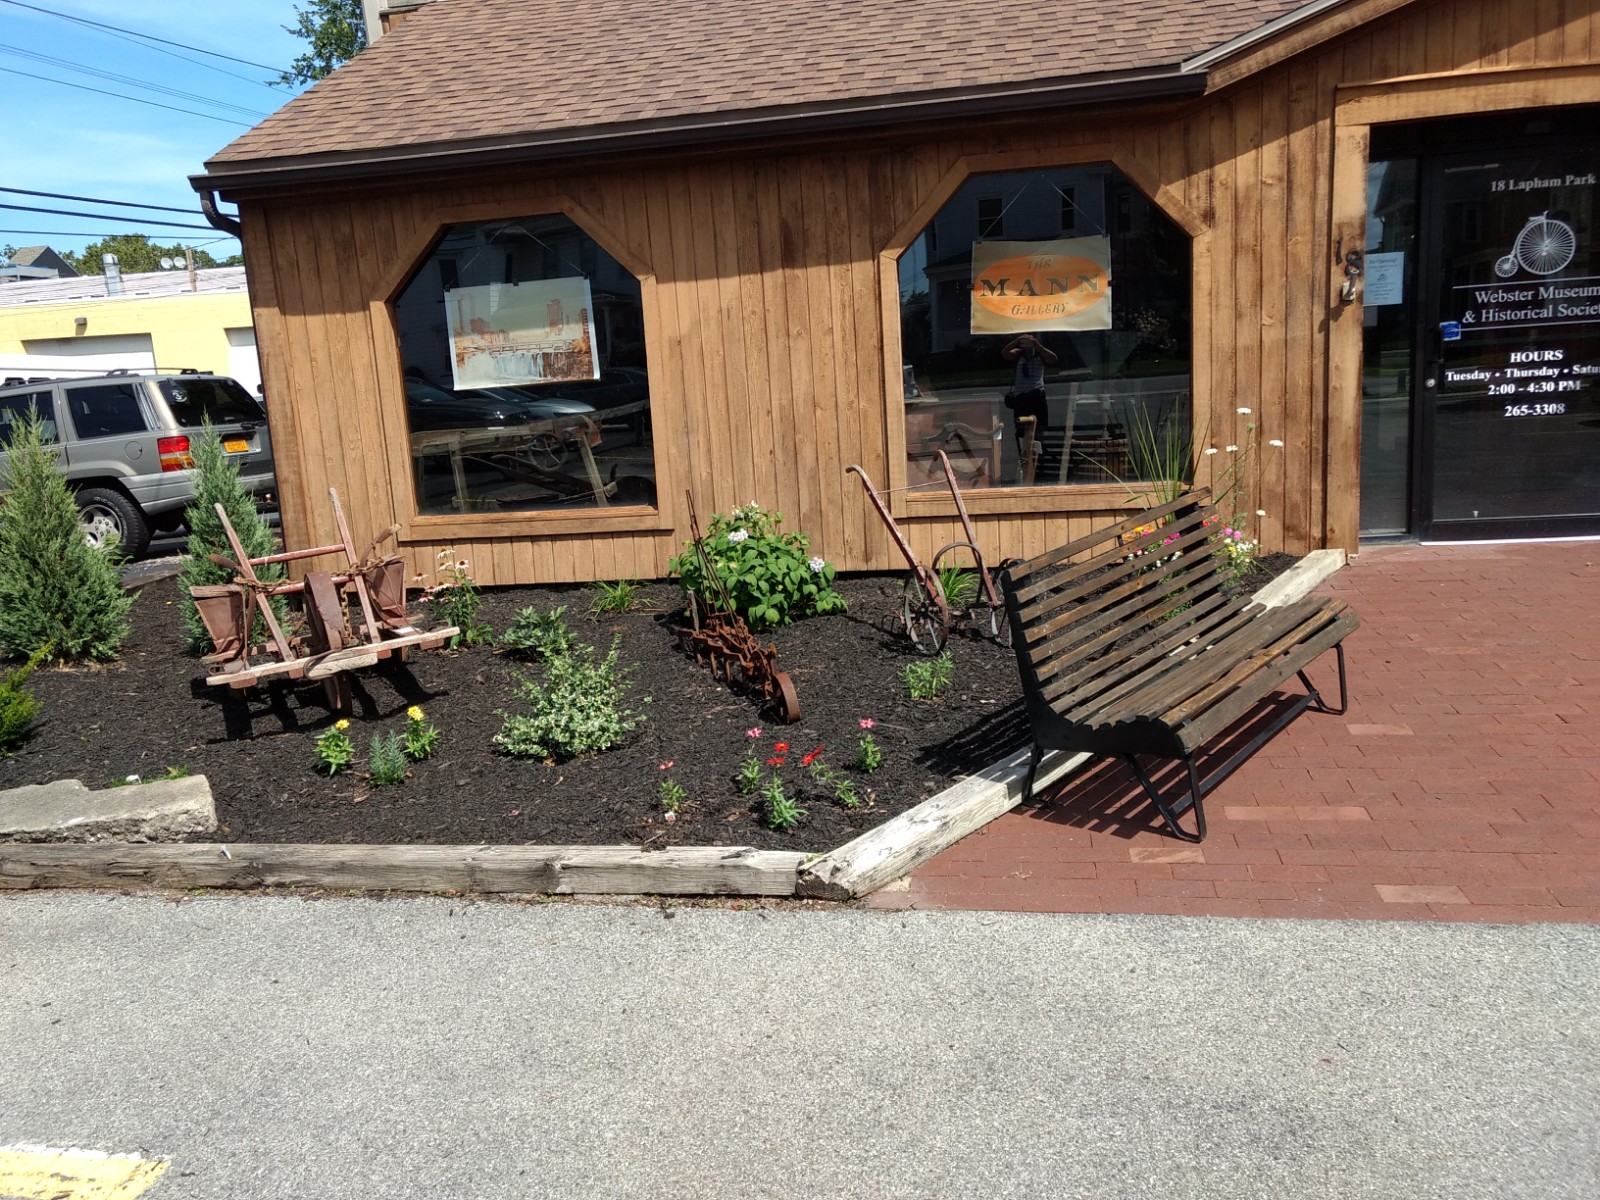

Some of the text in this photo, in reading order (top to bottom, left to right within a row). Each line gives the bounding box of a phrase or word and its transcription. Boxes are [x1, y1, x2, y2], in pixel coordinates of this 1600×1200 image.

[1490, 173, 1596, 192] 18 Lapham Park
[1026, 257, 1052, 270] THE
[977, 271, 1100, 298] MANN
[1475, 285, 1600, 304] Webster Museum
[1011, 302, 1070, 316] GALLERY
[1462, 310, 1476, 324] &
[1480, 304, 1553, 323] Historical
[1510, 349, 1564, 364] HOURS
[1445, 370, 1492, 382] Tuesday
[1504, 366, 1561, 379] Thursday
[1487, 383, 1516, 396] 2:00
[1526, 381, 1555, 393] 4:30
[1558, 380, 1583, 392] PM
[1504, 403, 1566, 417] 265-3308
